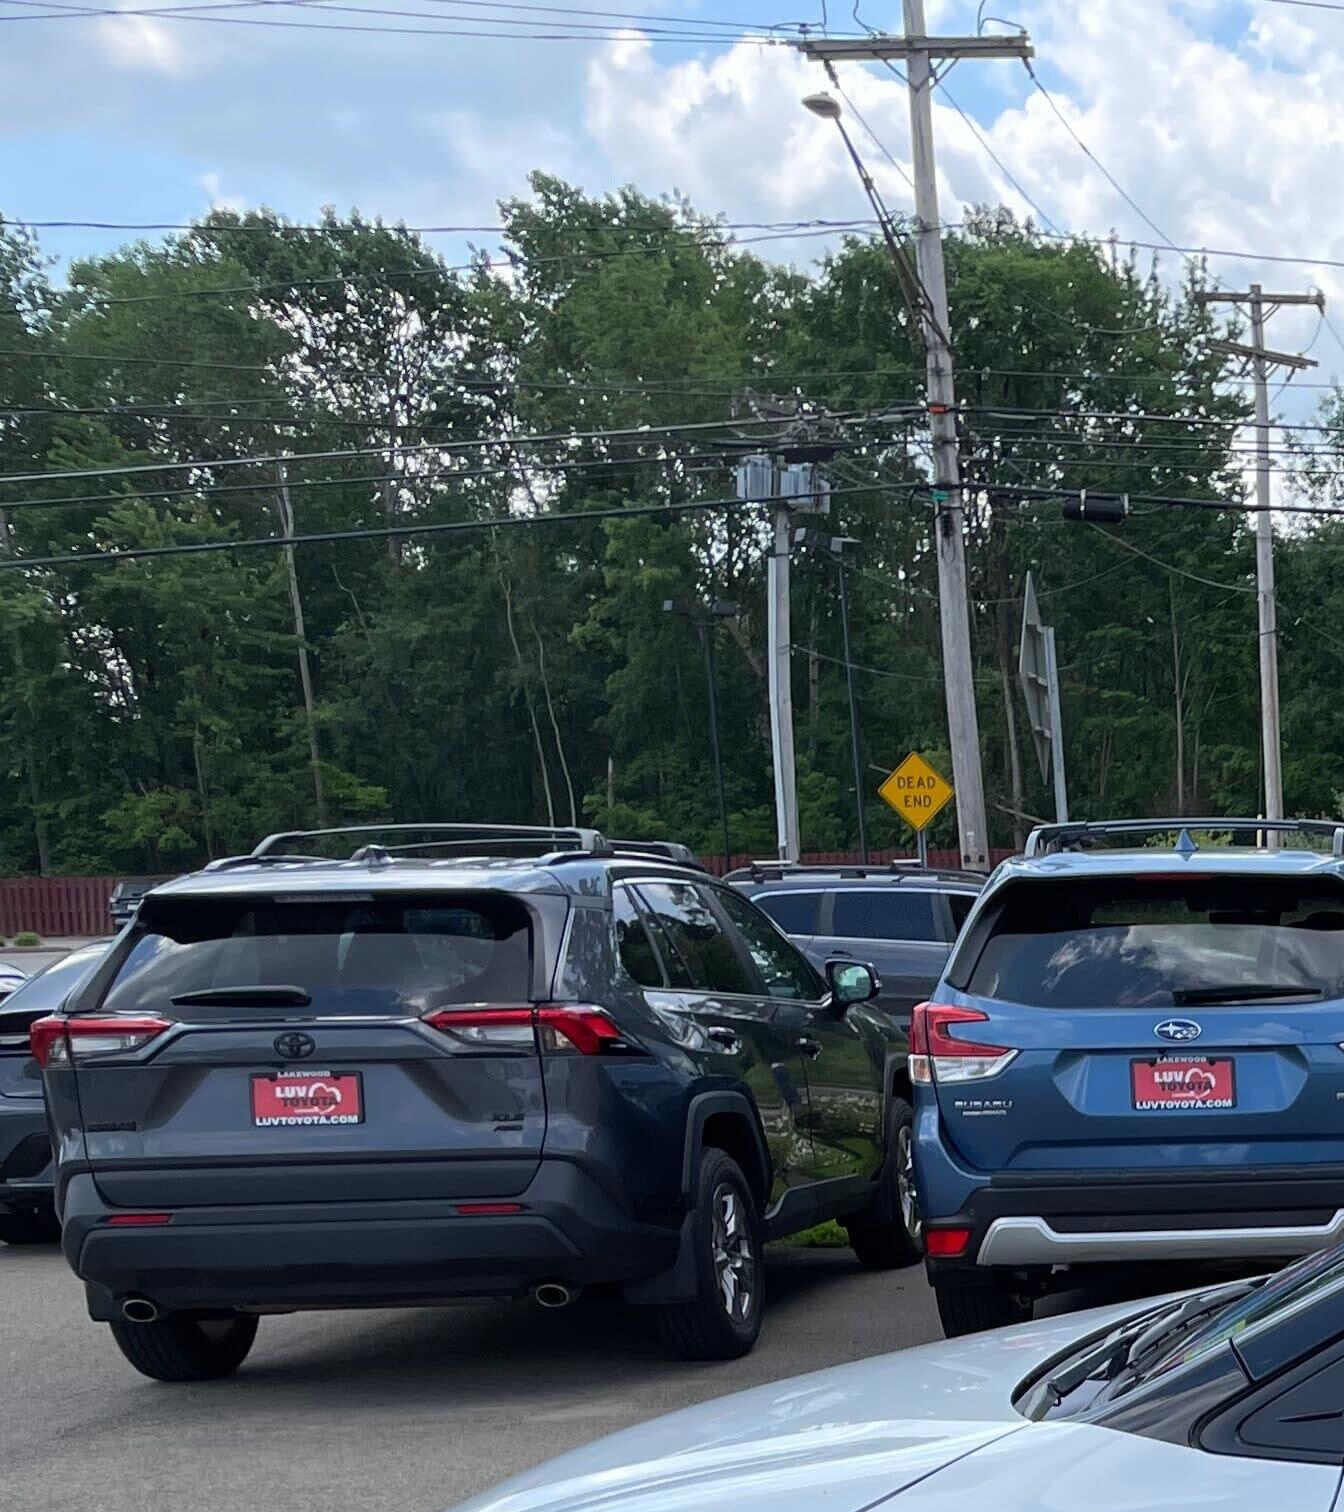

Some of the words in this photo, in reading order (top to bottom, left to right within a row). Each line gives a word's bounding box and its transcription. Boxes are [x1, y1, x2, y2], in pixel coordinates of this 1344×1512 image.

[897, 776, 936, 790] DEAD
[903, 795, 932, 808] END
[1154, 1071, 1183, 1083] LUV
[1160, 1081, 1213, 1091] TOYOTA
[275, 1086, 307, 1098] LUV
[282, 1097, 338, 1107] TOYOTA
[1136, 1099, 1233, 1110] LUVTOYOTA.COM
[256, 1115, 358, 1126] LUVTOYOTA.COM
